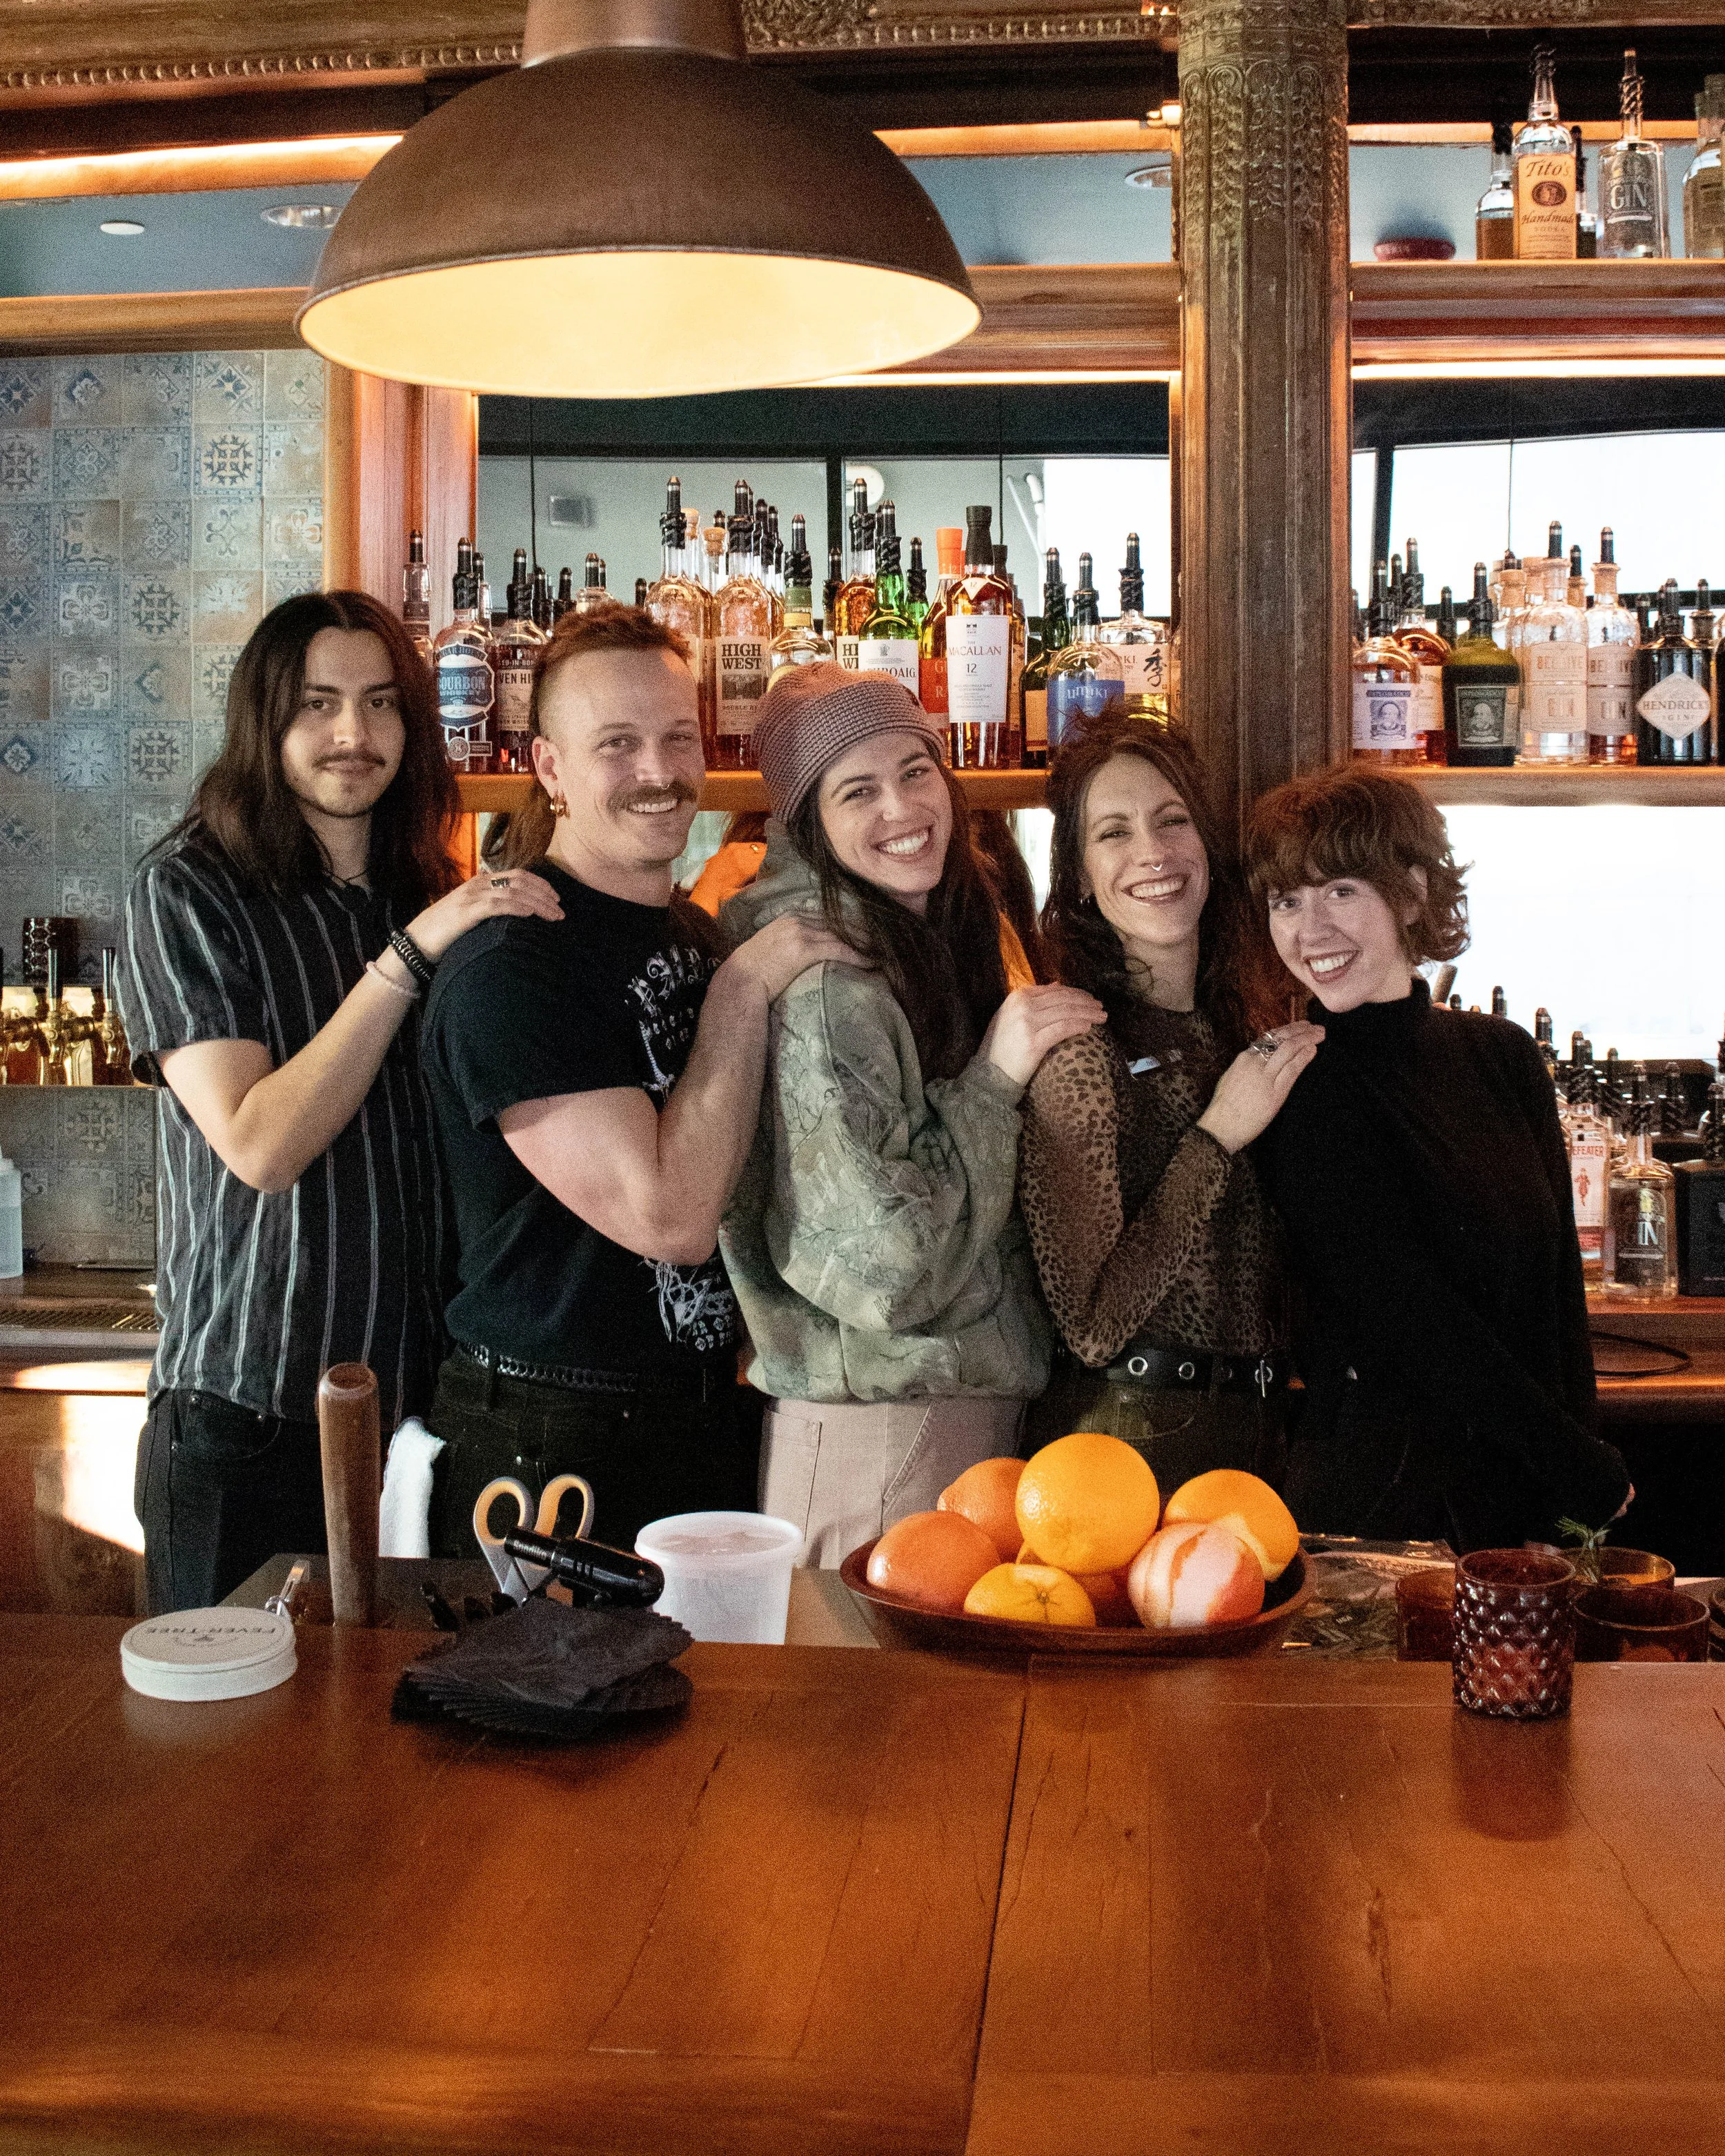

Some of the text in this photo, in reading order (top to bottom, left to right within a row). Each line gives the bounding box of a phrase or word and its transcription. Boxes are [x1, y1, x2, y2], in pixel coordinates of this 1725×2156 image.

[1526, 159, 1572, 177] Tito's
[1610, 183, 1648, 210] GIN
[722, 643, 762, 657] HIGH
[842, 644, 859, 656] HI
[949, 646, 1002, 656] MACALLAN
[722, 657, 762, 670] WEST
[1123, 655, 1136, 664] KI
[966, 663, 978, 673] 12
[520, 673, 531, 684] HI
[1637, 1221, 1659, 1245] IN
